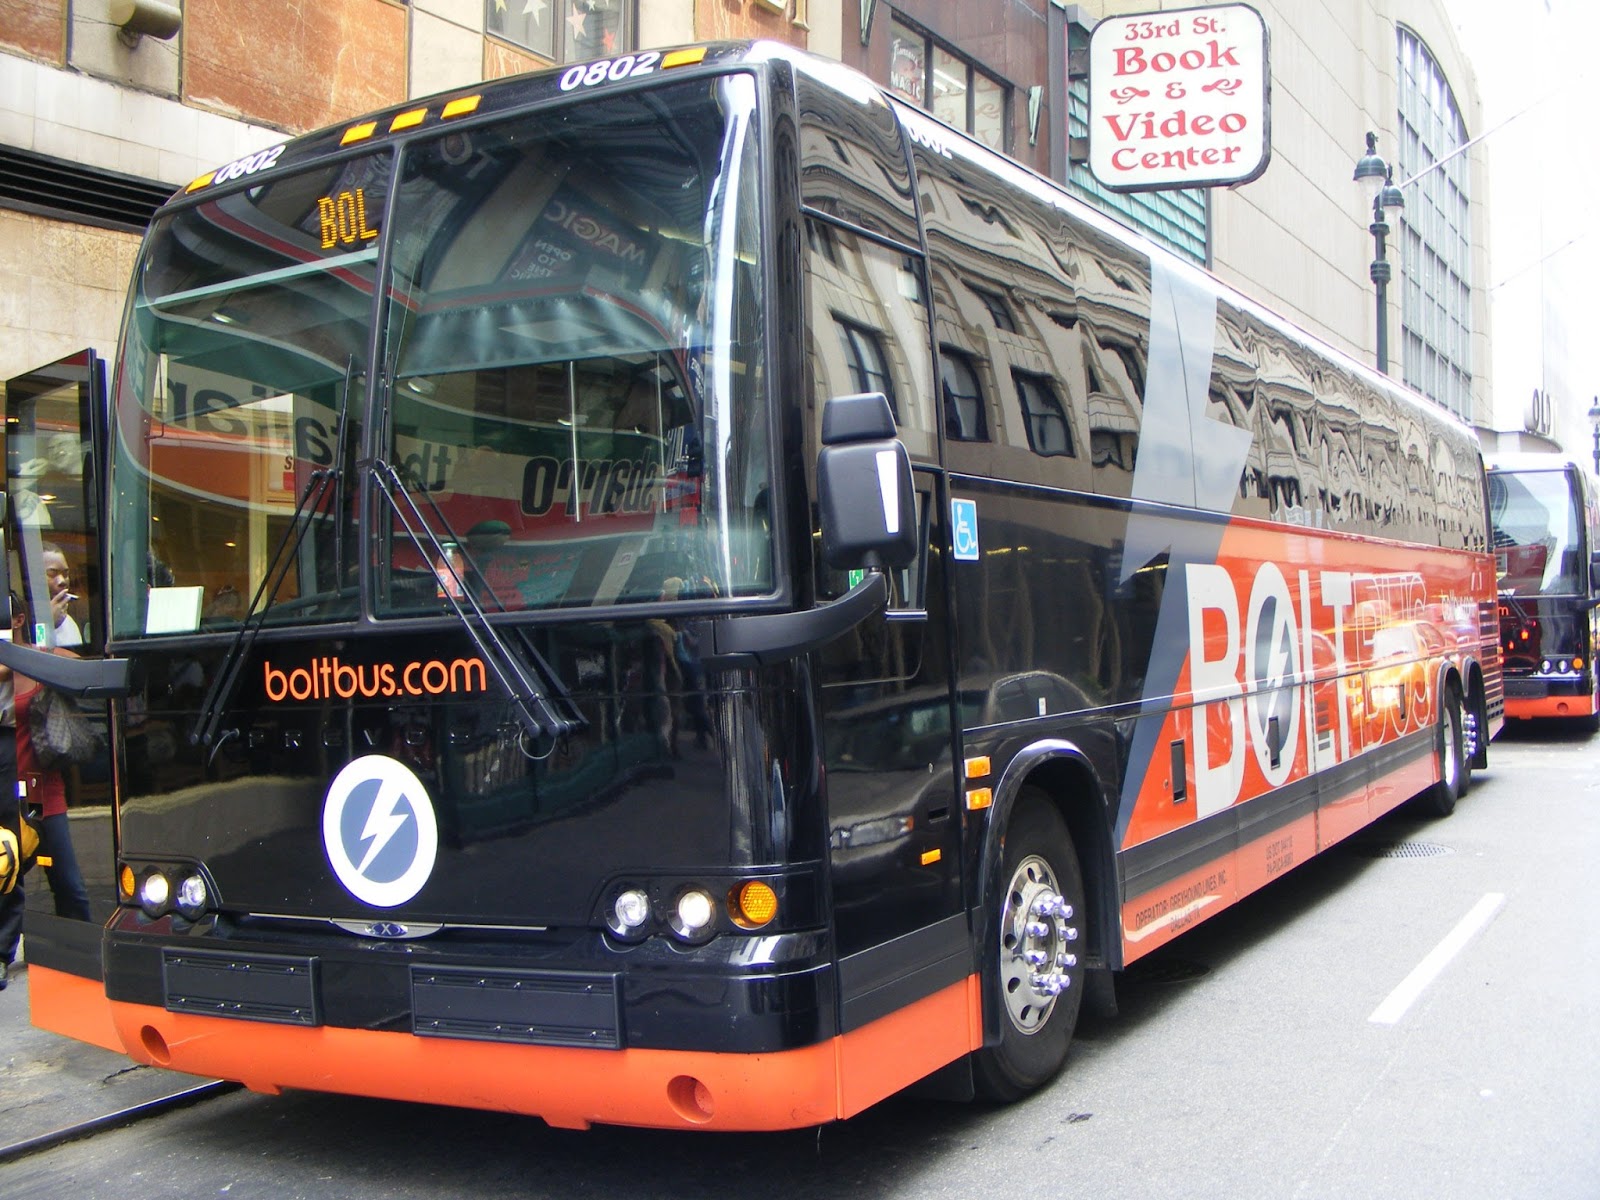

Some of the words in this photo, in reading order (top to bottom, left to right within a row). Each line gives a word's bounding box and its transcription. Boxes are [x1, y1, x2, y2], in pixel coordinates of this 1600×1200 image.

[1125, 19, 1180, 41] 33rd
[1192, 16, 1227, 35] St.
[560, 51, 661, 92] 0802
[1112, 39, 1241, 77] Book
[1165, 81, 1187, 100] &
[1102, 109, 1248, 142] Video
[214, 144, 288, 185] 0802
[1111, 146, 1242, 172] Center
[317, 188, 378, 249] BOL
[264, 657, 487, 701] boltbus.com
